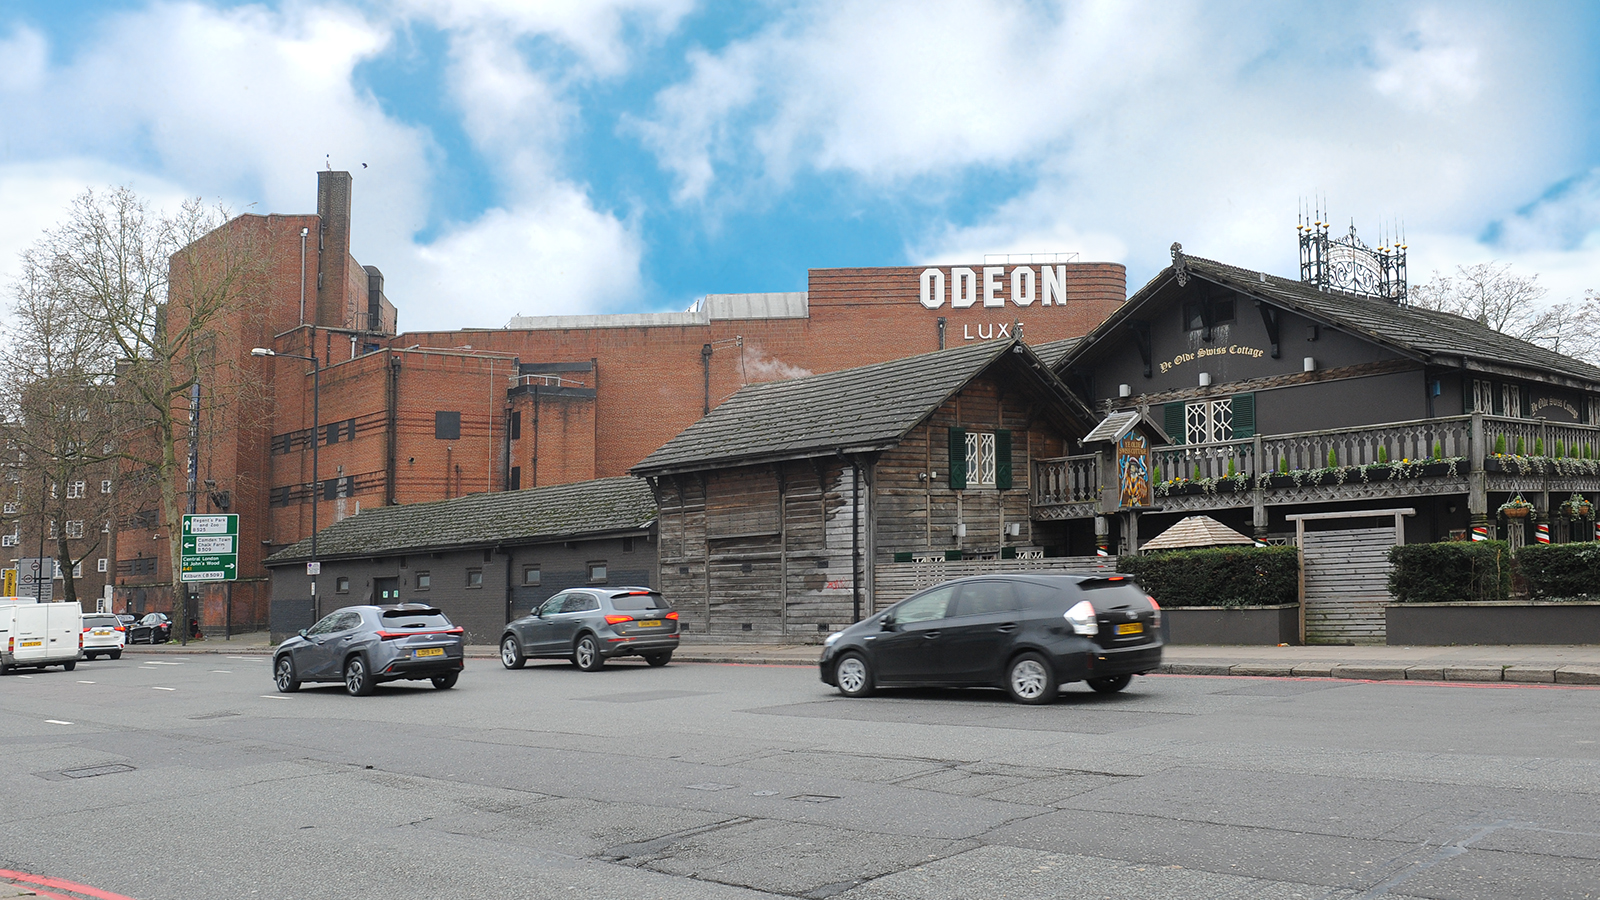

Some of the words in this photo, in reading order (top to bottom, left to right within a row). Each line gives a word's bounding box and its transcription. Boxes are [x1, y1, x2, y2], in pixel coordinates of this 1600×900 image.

[920, 265, 1067, 310] ODEON
[1160, 361, 1172, 374] Ye
[1173, 352, 1195, 366] Olde
[1197, 345, 1227, 358] Swiss
[1229, 344, 1264, 358] Cottage
